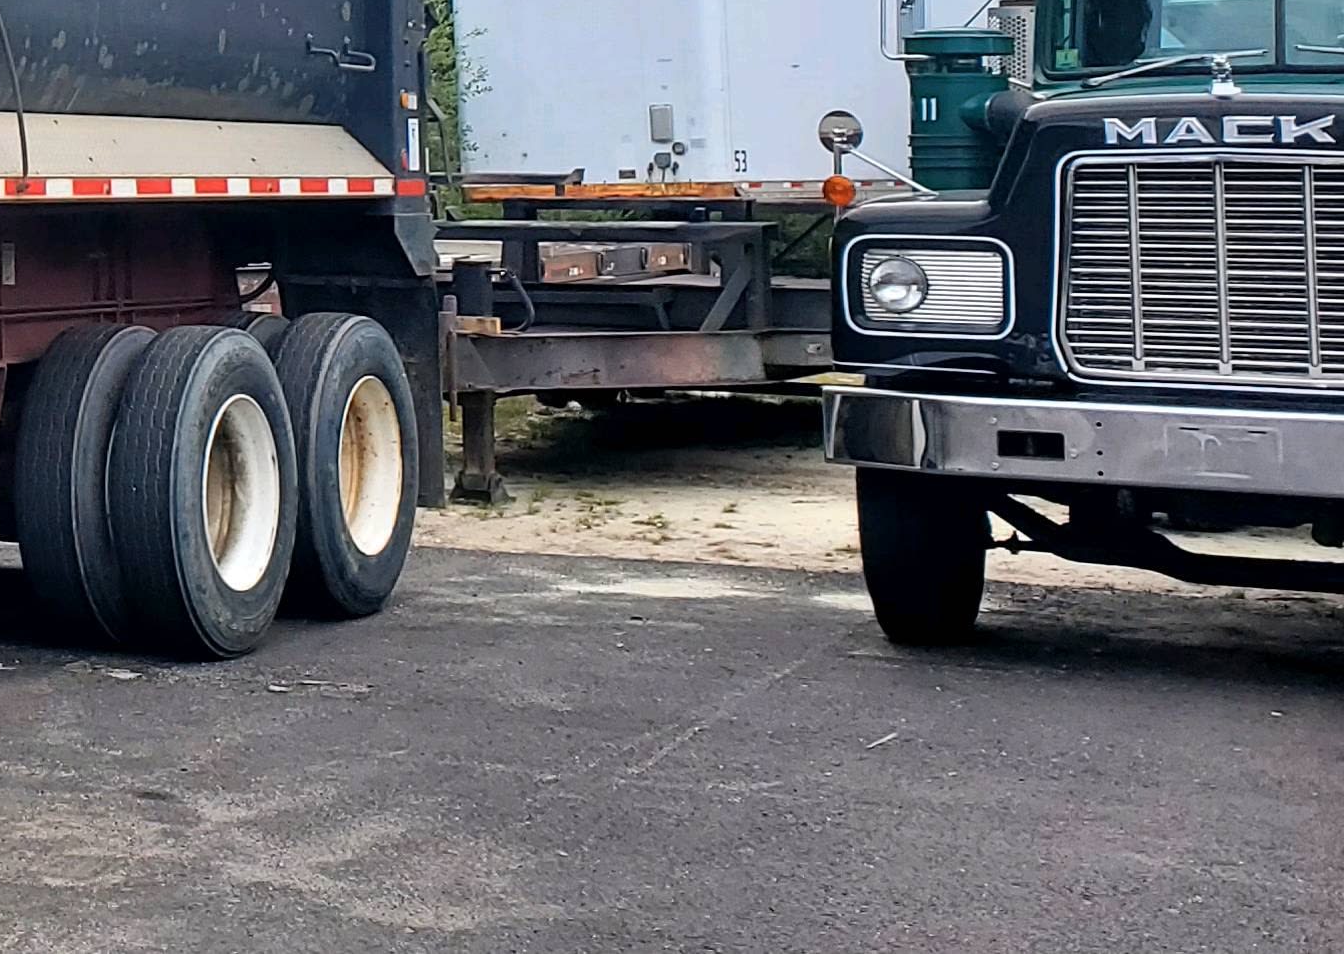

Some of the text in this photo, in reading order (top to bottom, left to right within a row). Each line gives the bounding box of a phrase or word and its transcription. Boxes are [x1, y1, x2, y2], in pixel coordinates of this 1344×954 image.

[921, 97, 937, 121] 11
[1103, 114, 1337, 145] MACK
[734, 150, 747, 172] 53
